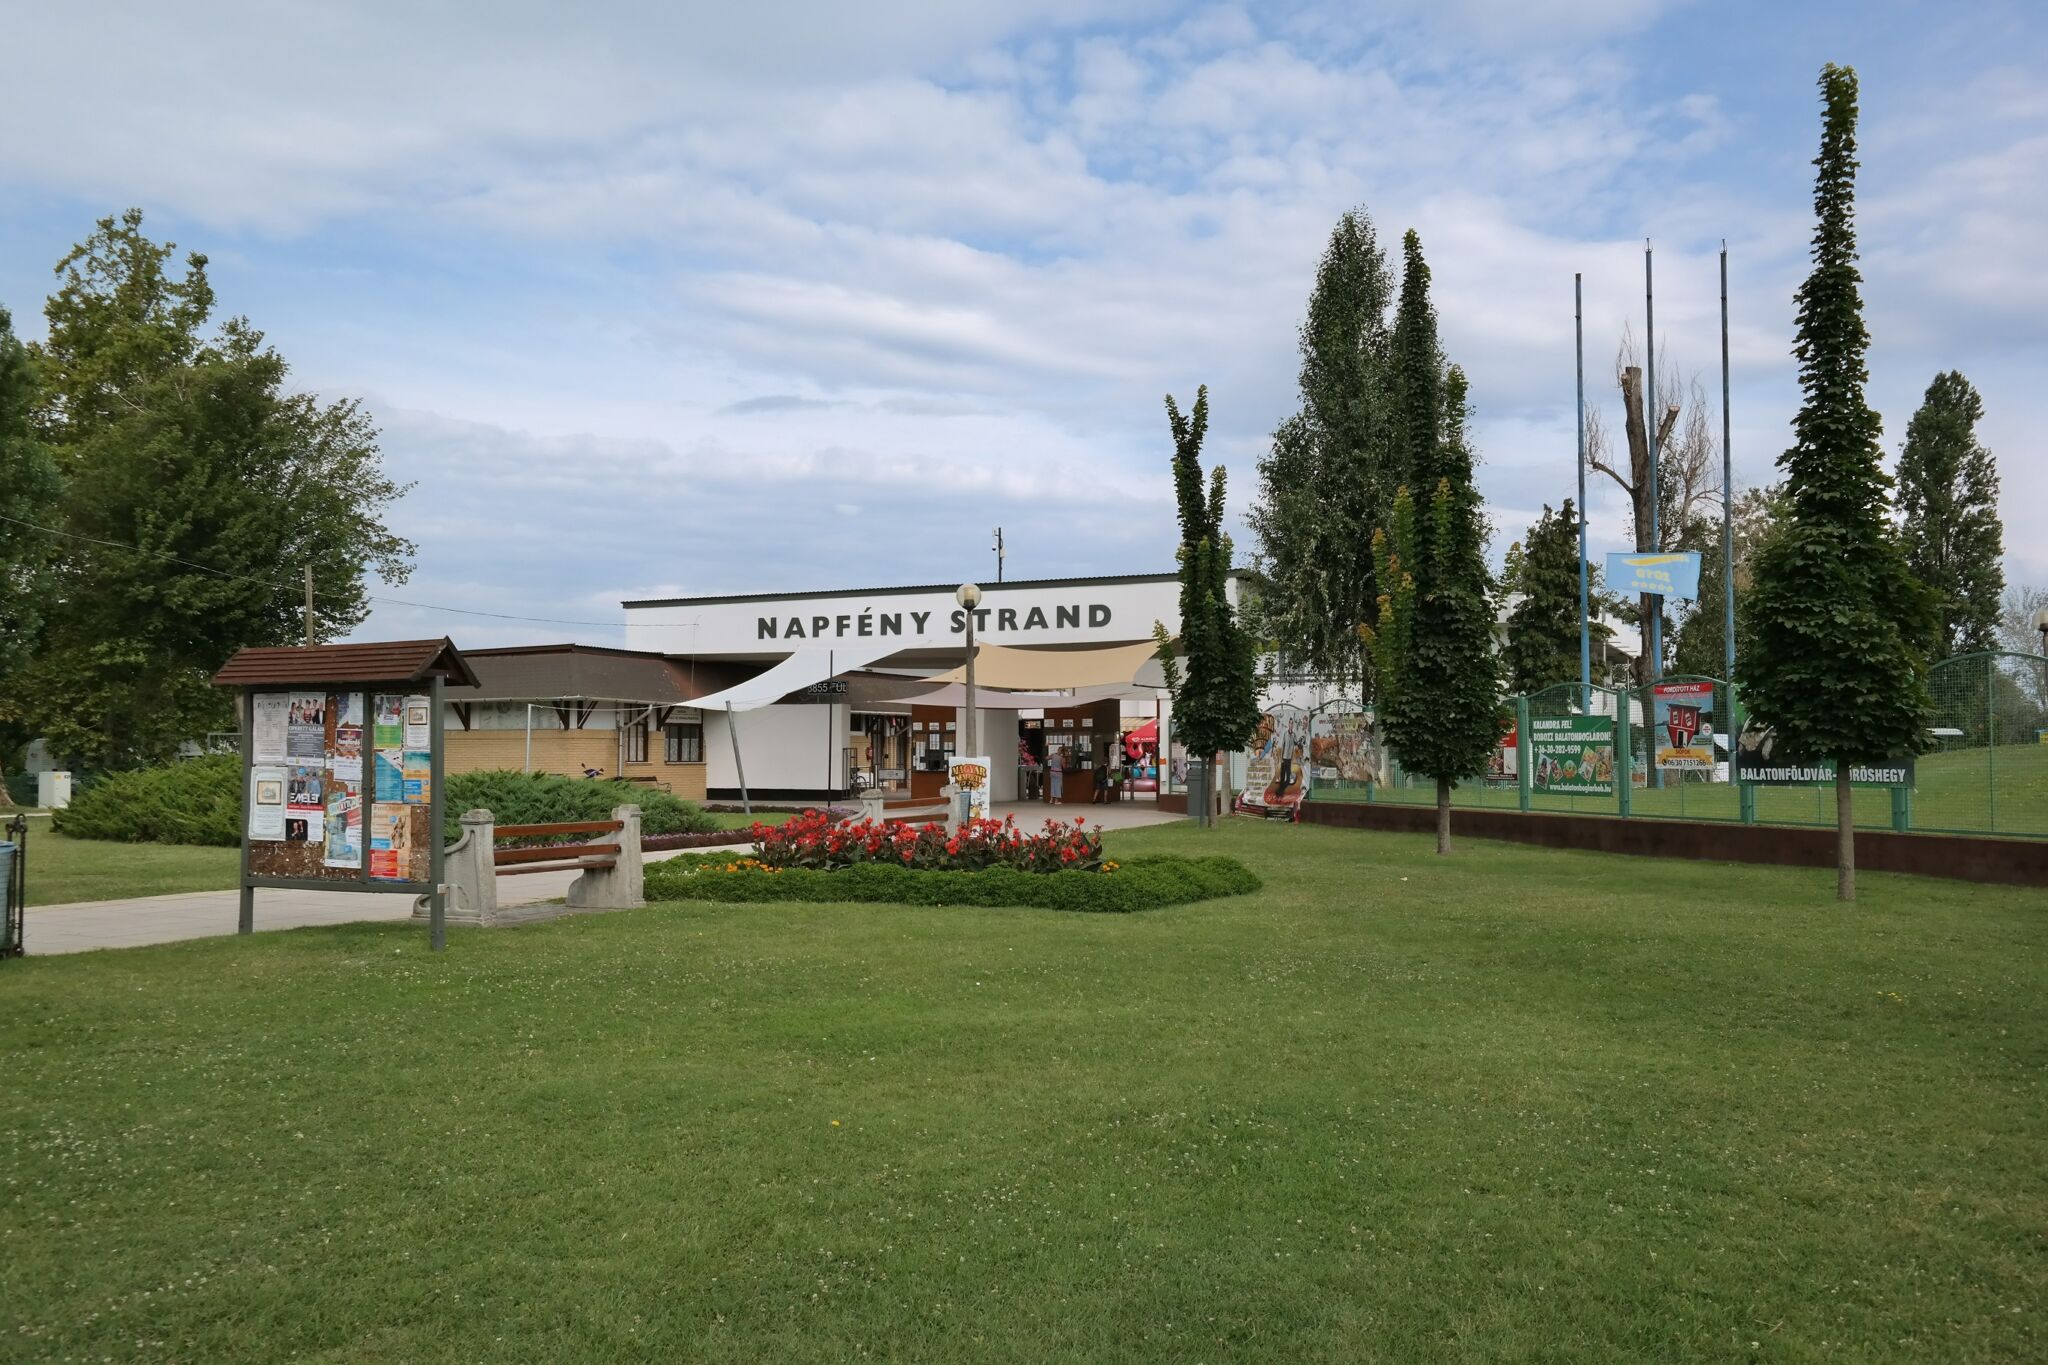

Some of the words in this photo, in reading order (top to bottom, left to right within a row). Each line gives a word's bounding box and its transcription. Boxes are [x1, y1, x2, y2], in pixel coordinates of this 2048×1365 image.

[757, 606, 931, 639] NAPFÉNY
[950, 604, 1112, 633] STRAND
[1533, 720, 1560, 729] KALANDRA
